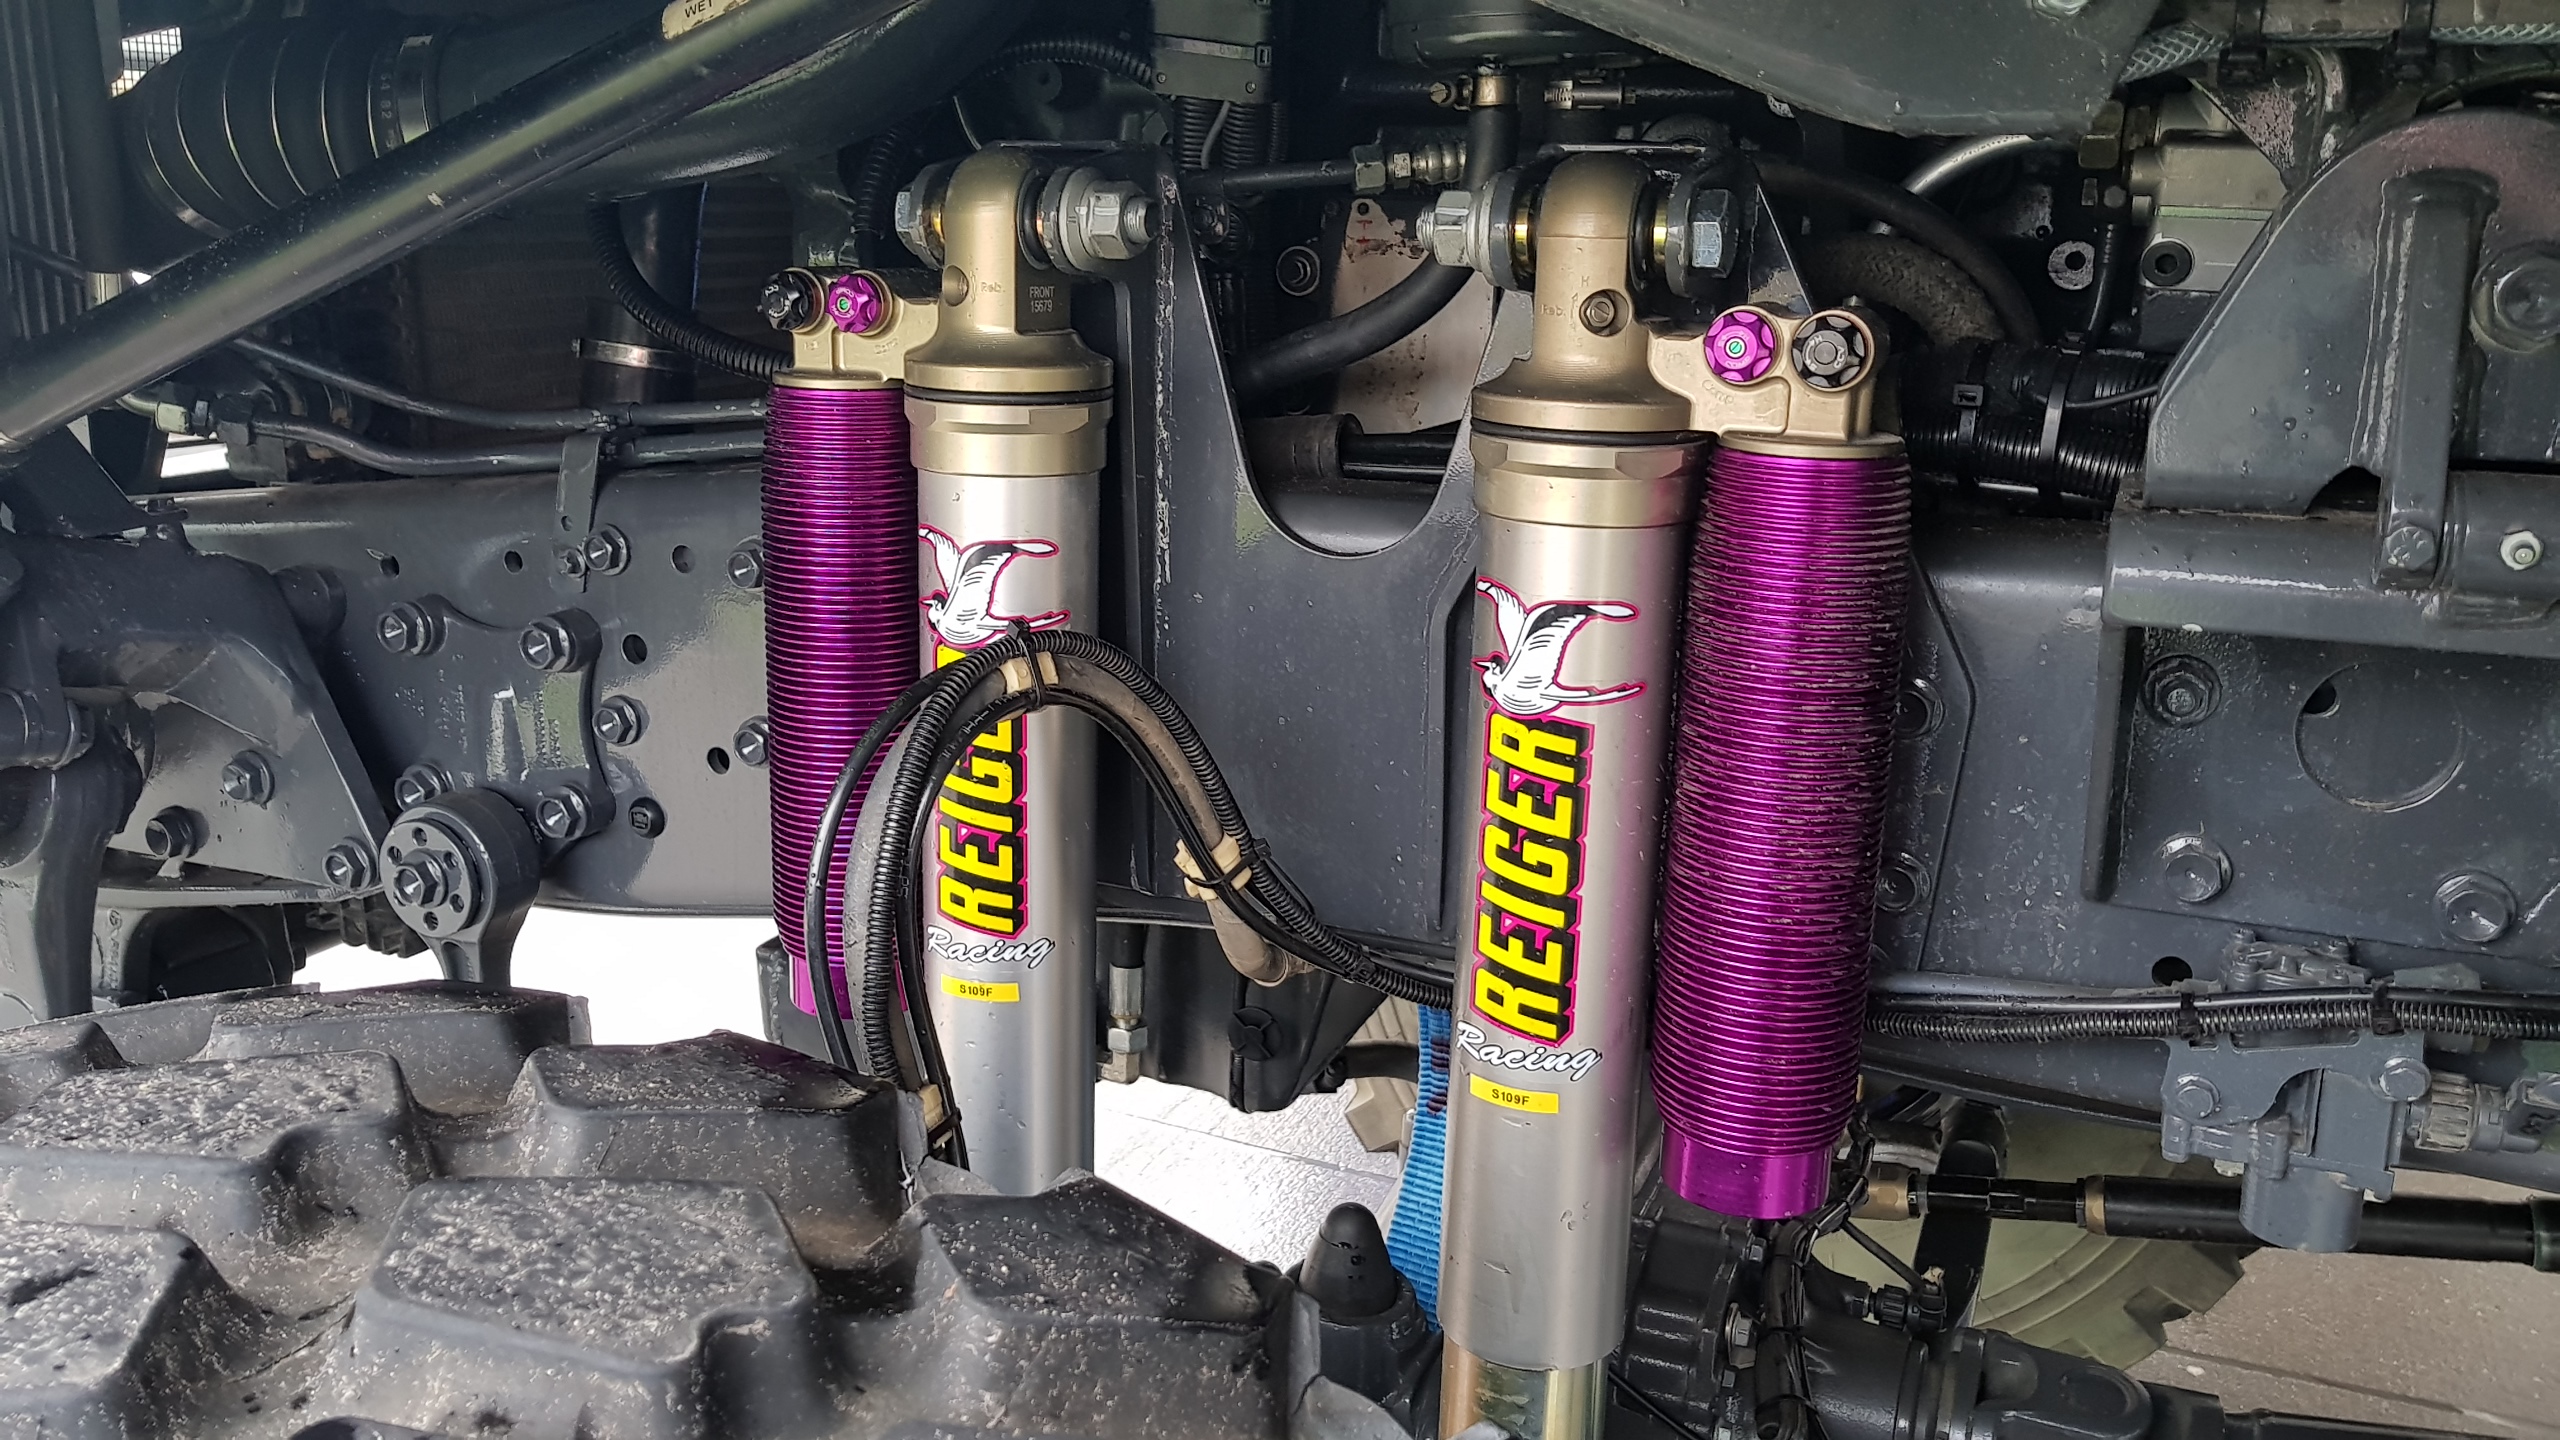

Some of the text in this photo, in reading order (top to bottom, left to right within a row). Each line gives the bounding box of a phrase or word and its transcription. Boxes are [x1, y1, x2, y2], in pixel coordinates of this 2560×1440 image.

[1029, 286, 1055, 298] FRONT
[1030, 300, 1053, 312] 15679
[936, 643, 1028, 939] REIG
[1472, 707, 1591, 1046] REIGER
[927, 925, 1055, 969] Racing
[960, 984, 993, 997] S109F
[1456, 1020, 1602, 1082] Racing
[1491, 1088, 1530, 1106] S109F
